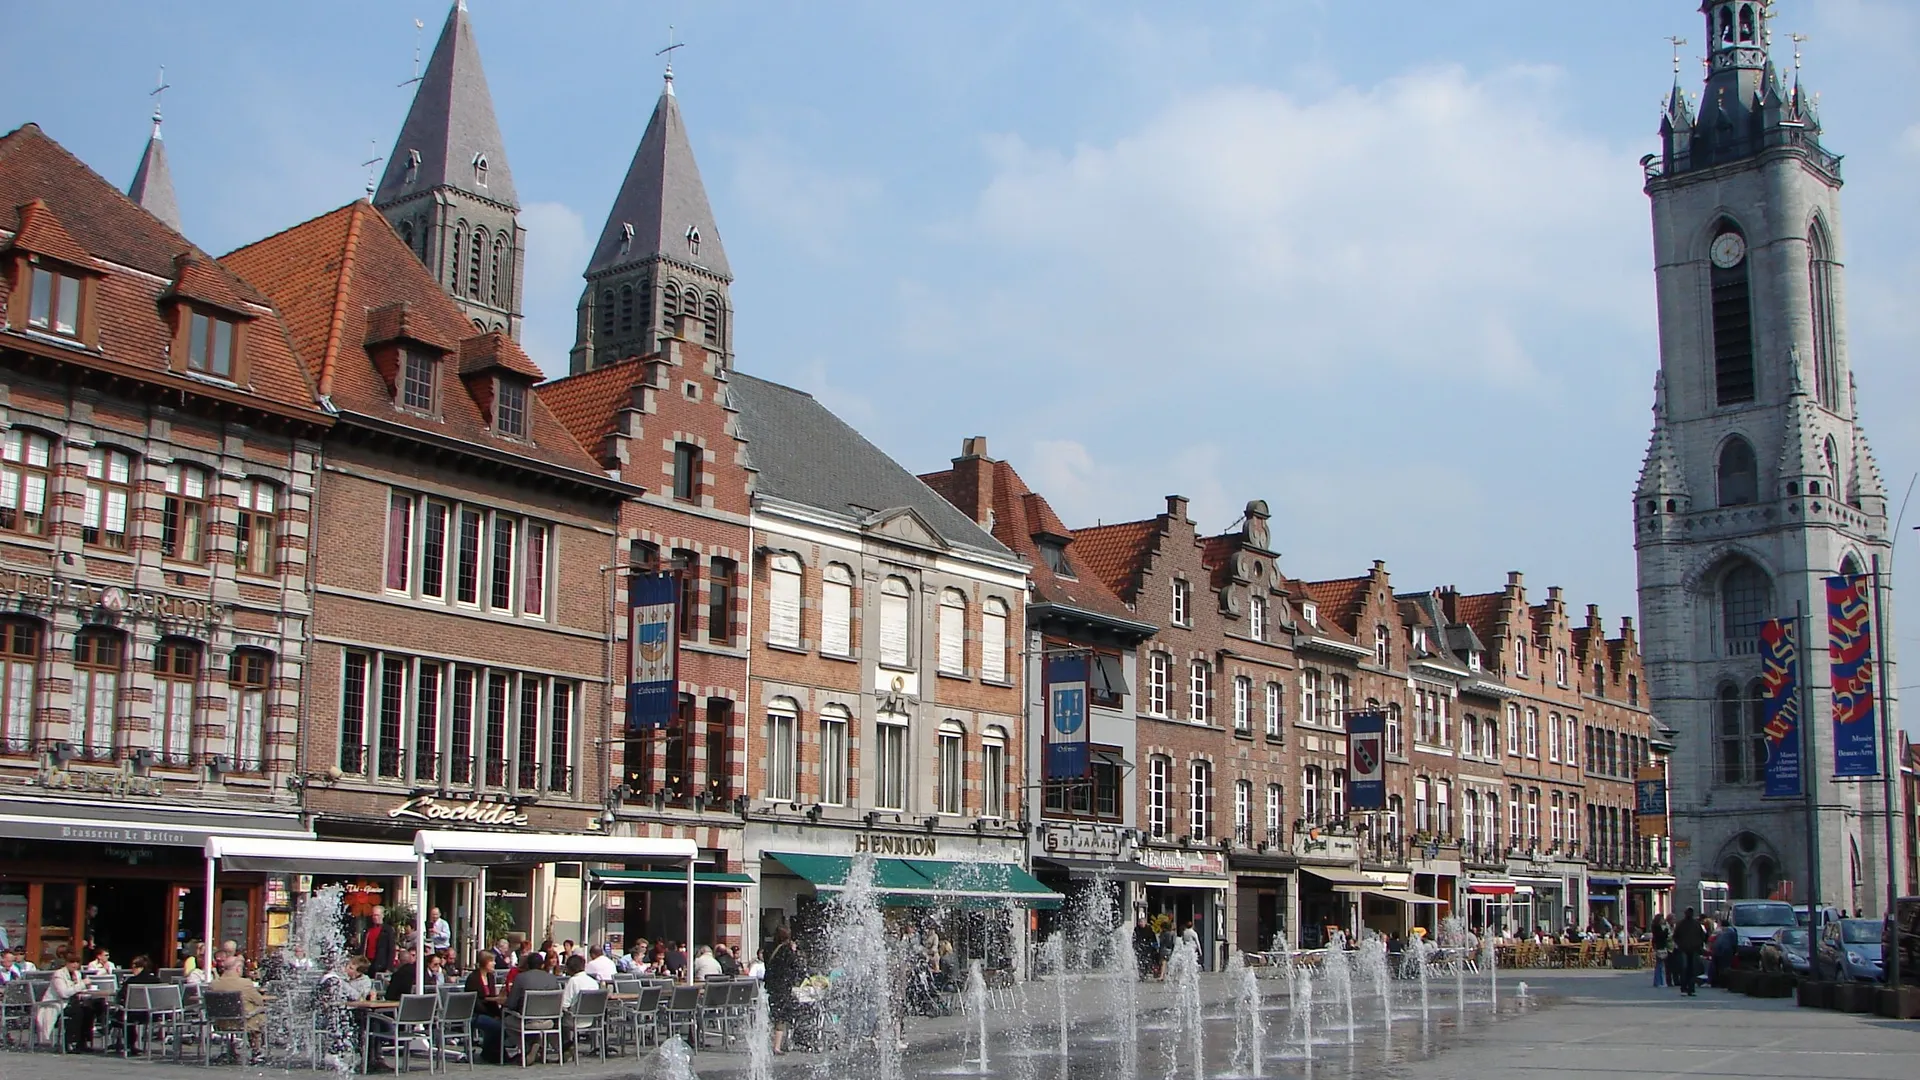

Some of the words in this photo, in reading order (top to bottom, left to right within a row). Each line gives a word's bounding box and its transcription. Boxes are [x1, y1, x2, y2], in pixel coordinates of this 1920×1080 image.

[128, 592, 226, 624] ARTOIS
[388, 796, 528, 826] L'orchidée
[62, 827, 119, 839] Brasserie
[125, 830, 138, 840] Le
[145, 831, 184, 843] Beffroi
[855, 834, 937, 856] HENRION
